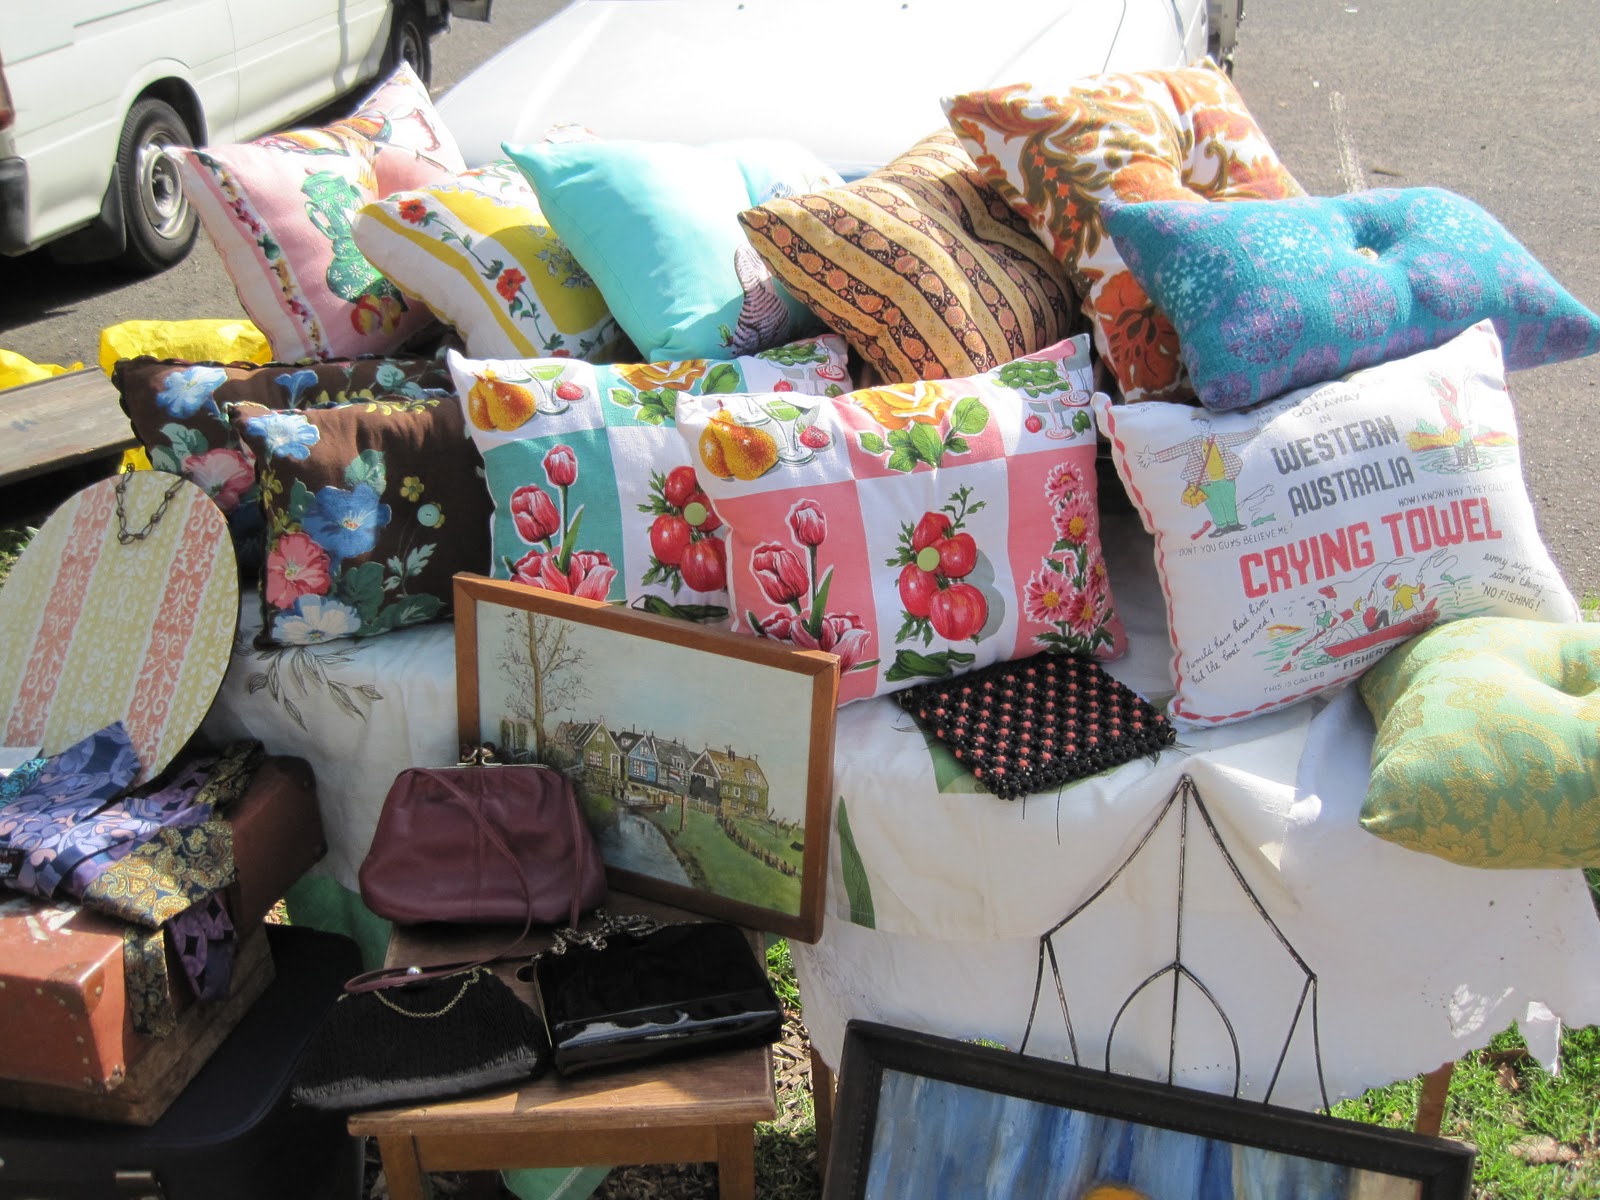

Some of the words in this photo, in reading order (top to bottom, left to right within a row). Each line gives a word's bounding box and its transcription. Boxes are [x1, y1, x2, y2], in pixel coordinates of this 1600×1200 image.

[1279, 400, 1302, 411] ONE
[1292, 402, 1320, 418] GOT
[1323, 392, 1360, 409] AWAY
[1319, 413, 1333, 424] IN
[1270, 415, 1400, 475] WESTERN
[1287, 456, 1416, 517] AUSTRALIA
[1421, 490, 1445, 502] KNOW
[1446, 487, 1464, 498] WHY
[1467, 483, 1487, 495] THEY
[1200, 543, 1217, 554] YOU
[1218, 538, 1241, 550] GUYS
[1243, 529, 1277, 545] BELIEVE
[1239, 521, 1376, 598] CRYING
[1381, 497, 1502, 557] TOWEL
[1482, 553, 1508, 570] every
[1511, 561, 1533, 575] sign
[1489, 571, 1516, 583] same
[1520, 575, 1545, 597] thing
[1191, 644, 1213, 669] would
[1214, 636, 1233, 649] have
[1232, 613, 1250, 632] had
[1249, 599, 1269, 616] him
[1206, 660, 1221, 673] the
[1222, 643, 1240, 661] boat
[1264, 684, 1282, 693] THIS
[1285, 681, 1292, 690] IS
[1294, 671, 1325, 686] CALLED
